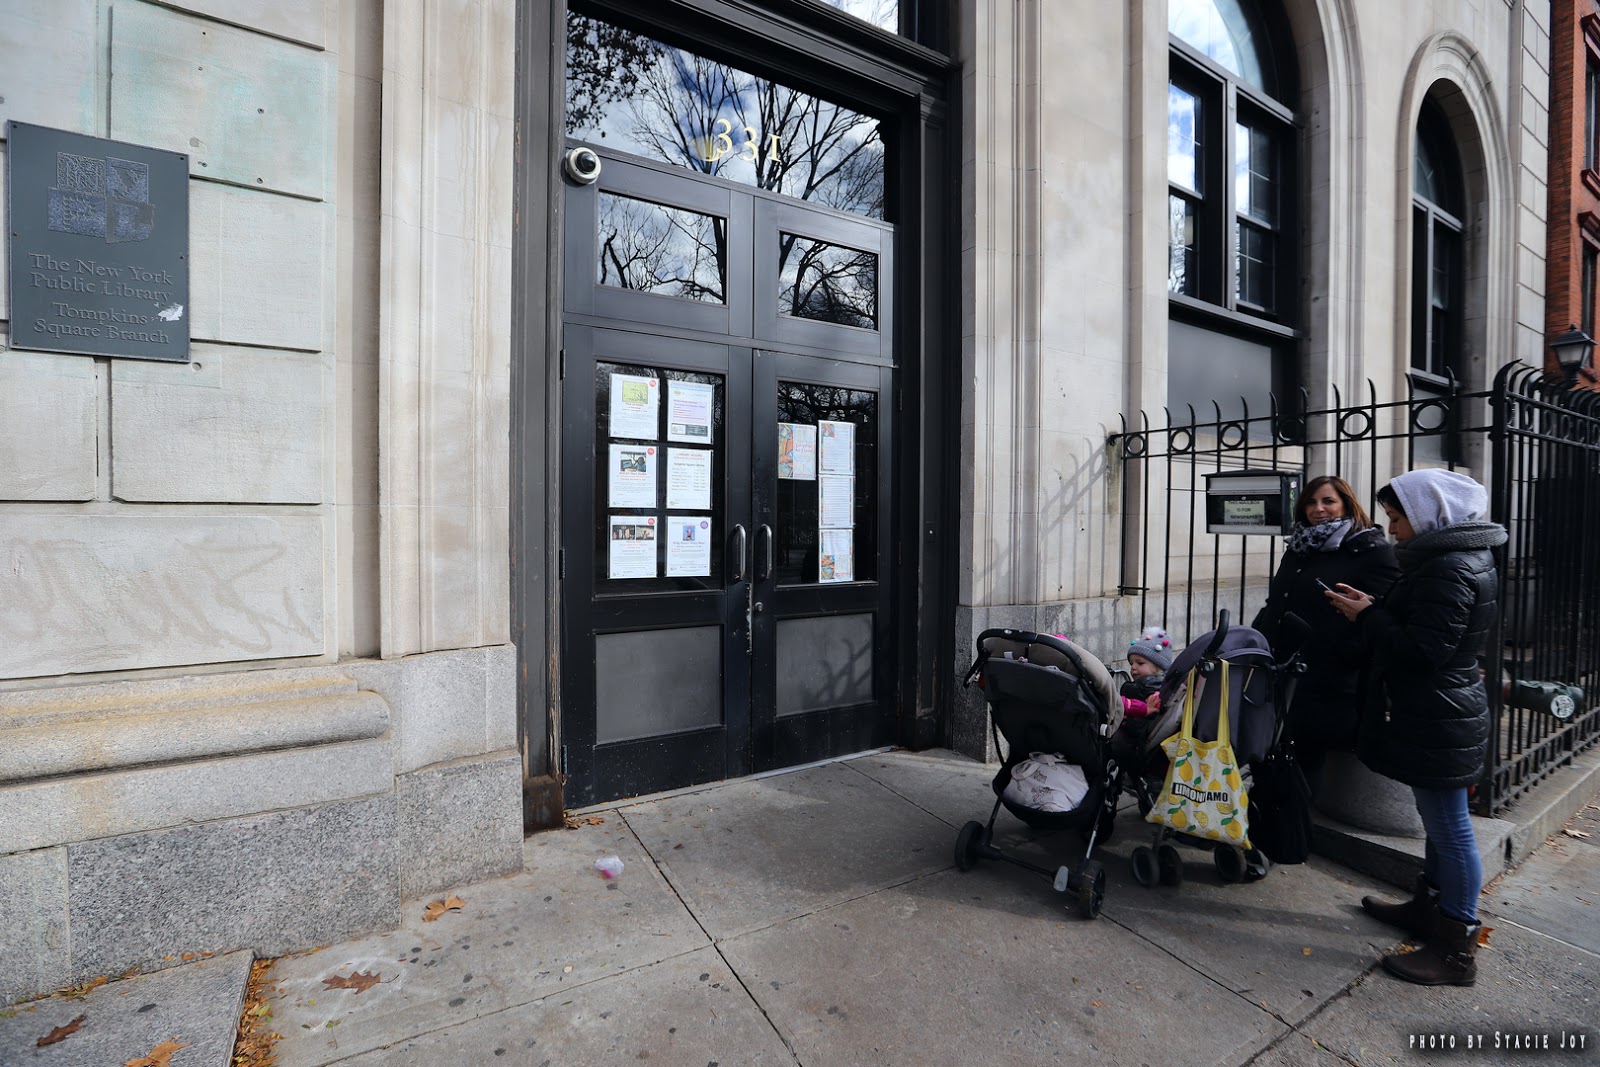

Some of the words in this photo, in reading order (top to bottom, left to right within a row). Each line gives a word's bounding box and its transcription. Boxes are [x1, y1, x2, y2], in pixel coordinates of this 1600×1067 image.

[716, 118, 782, 162] 331
[28, 252, 70, 272] The
[75, 258, 124, 276] New
[128, 265, 173, 286] York
[30, 271, 96, 293] Public
[100, 280, 173, 303] Library
[51, 301, 148, 325] Tompkins
[33, 318, 101, 339] Square
[104, 325, 170, 345] Branch
